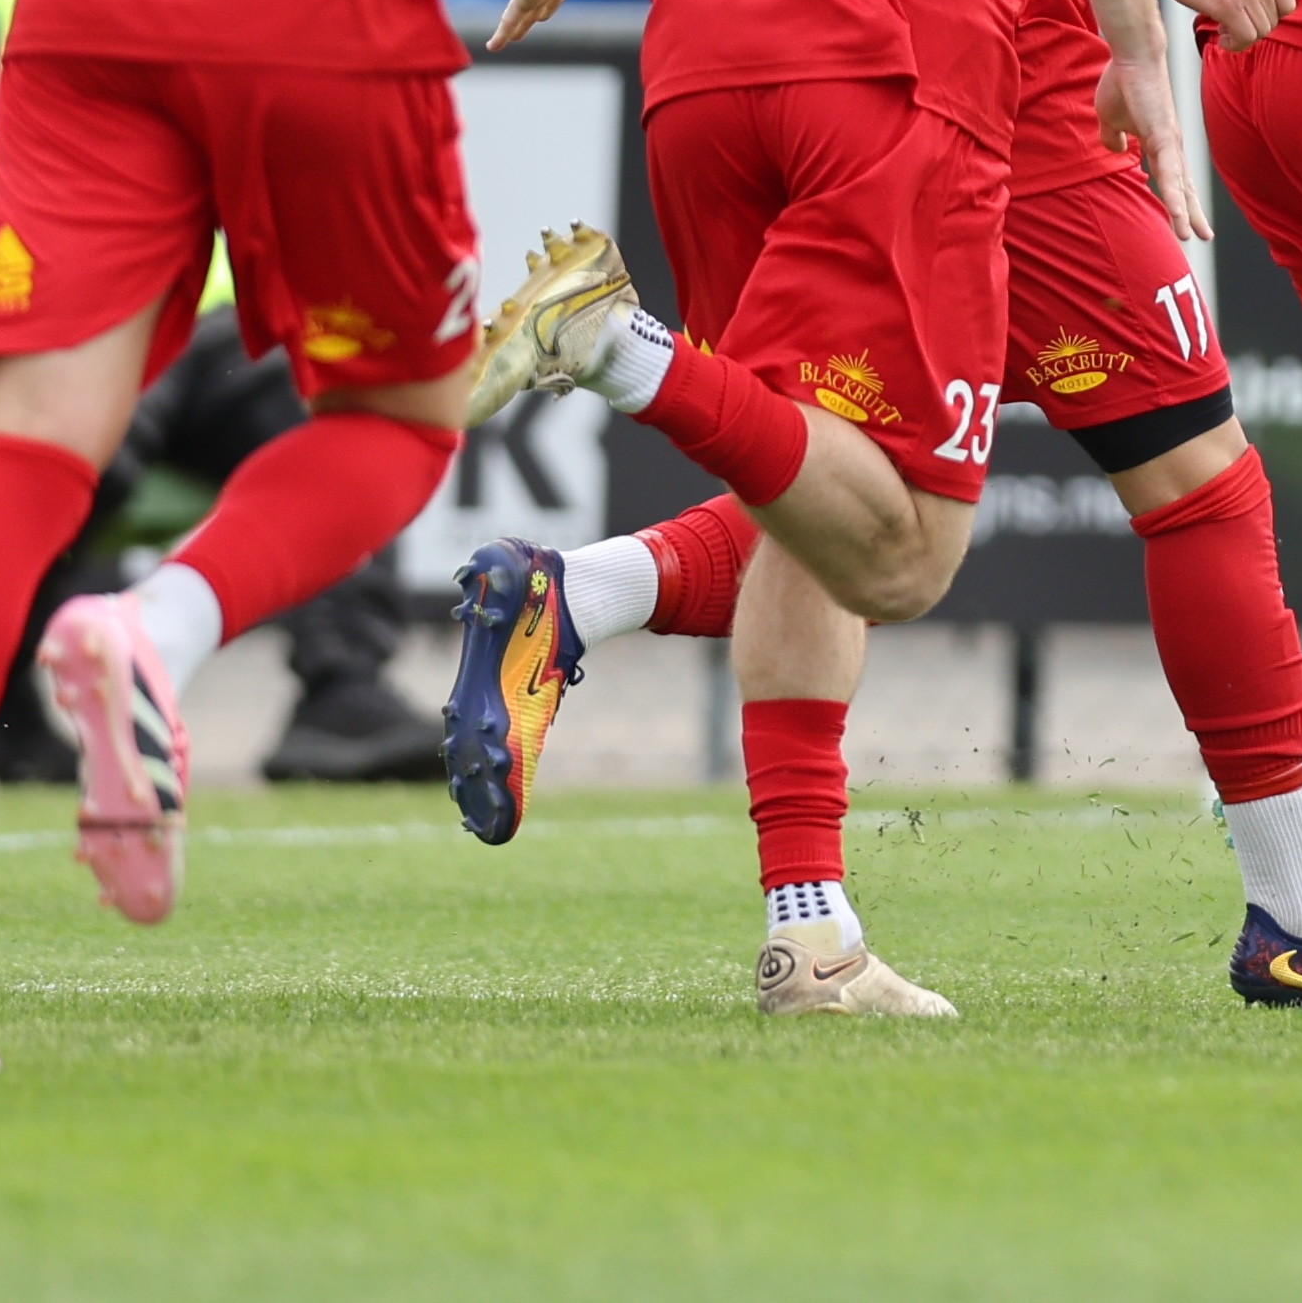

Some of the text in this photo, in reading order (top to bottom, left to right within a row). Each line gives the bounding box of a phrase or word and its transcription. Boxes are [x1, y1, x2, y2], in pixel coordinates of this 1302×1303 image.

[1154, 271, 1209, 364] 17
[799, 361, 904, 427] BLACKBUTT
[932, 378, 1002, 466] 23
